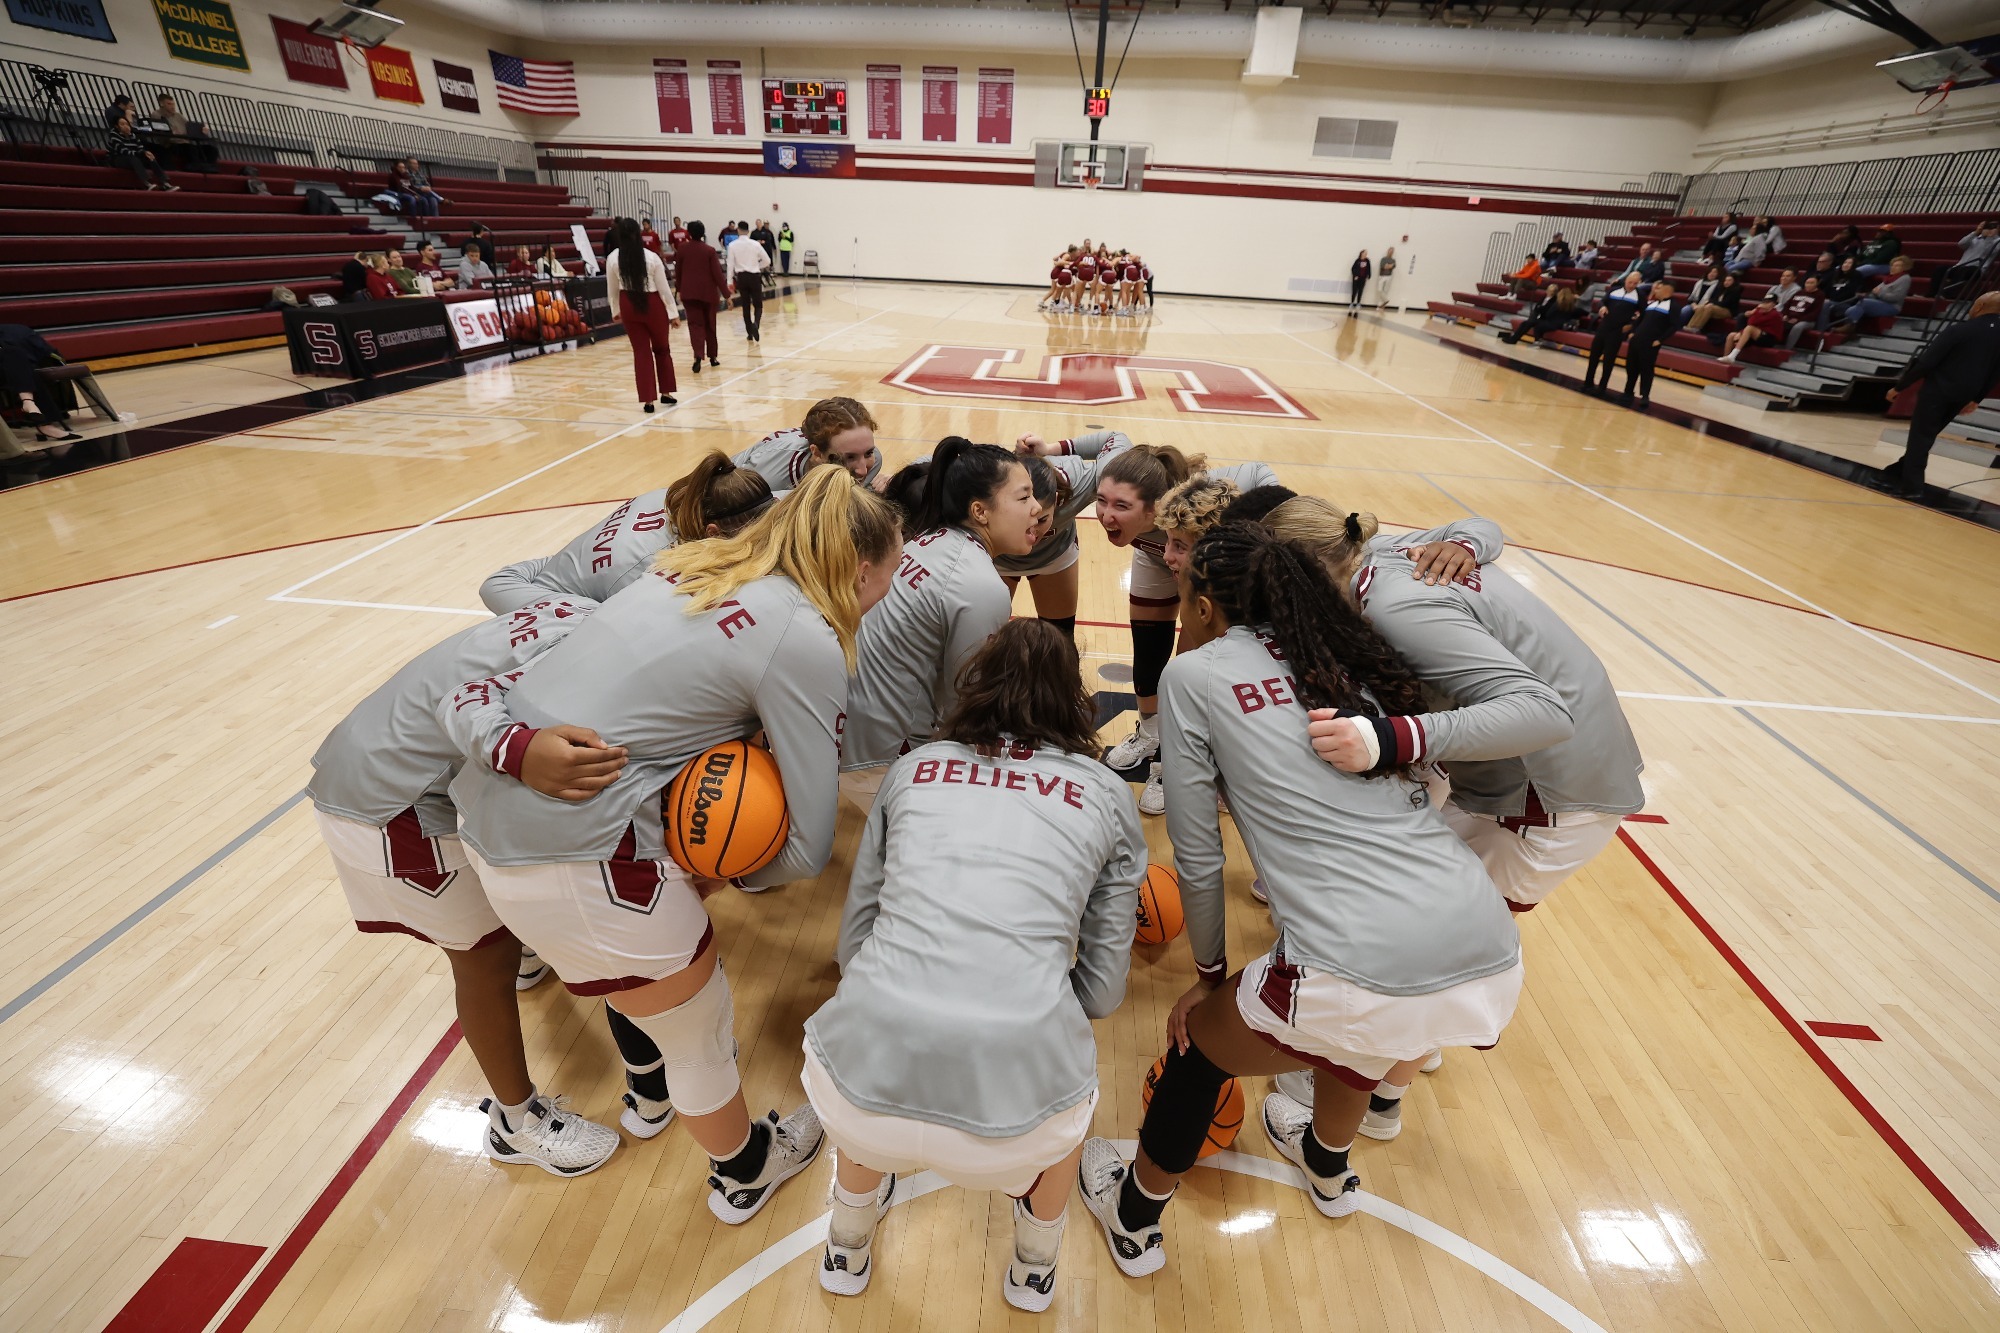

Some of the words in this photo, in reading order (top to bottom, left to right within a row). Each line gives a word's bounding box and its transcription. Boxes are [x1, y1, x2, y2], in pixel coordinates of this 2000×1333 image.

[21, 0, 95, 27] HOPKINS
[158, 0, 234, 32] McDANIEL
[169, 28, 240, 57] COLLEGE
[373, 61, 413, 87] URSINUS
[774, 89, 782, 104] 0
[836, 91, 845, 105] 0
[1088, 99, 1106, 116] 30
[303, 322, 343, 365] S
[353, 329, 378, 360] S
[912, 759, 1085, 810] BELIEVE
[690, 752, 736, 847] Wilson
